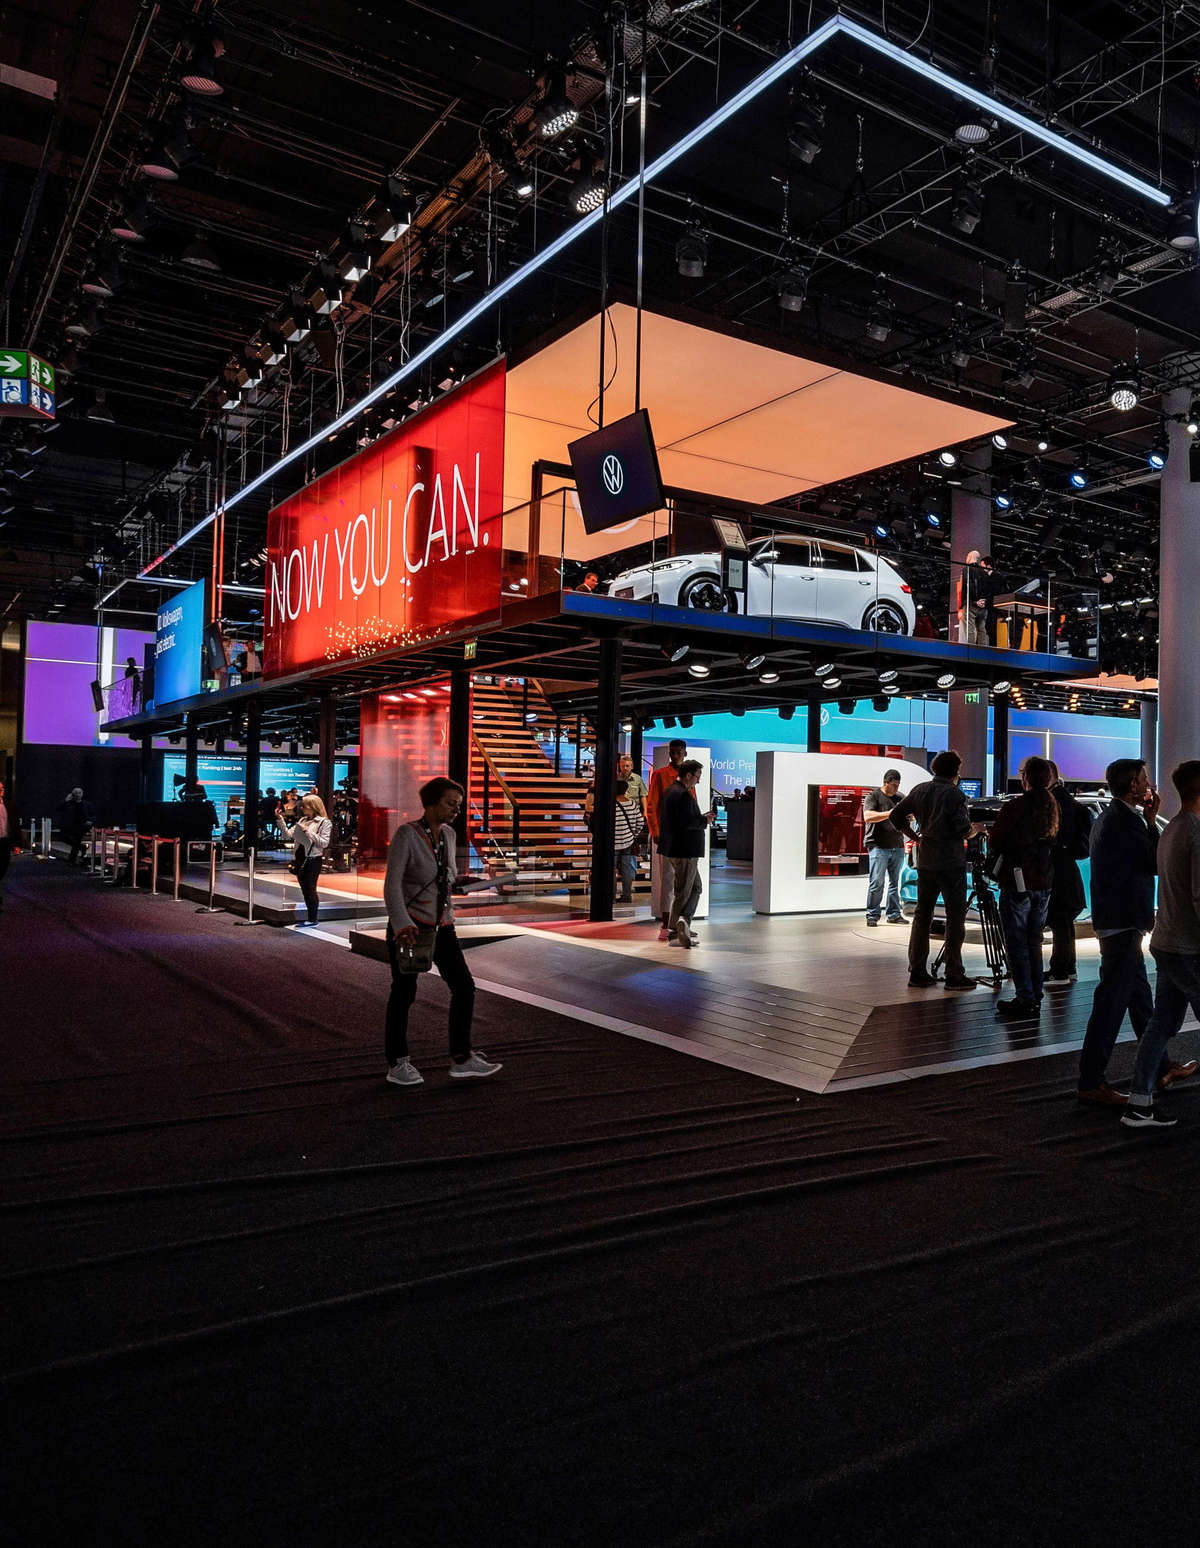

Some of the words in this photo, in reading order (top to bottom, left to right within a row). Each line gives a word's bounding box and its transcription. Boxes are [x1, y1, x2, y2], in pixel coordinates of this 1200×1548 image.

[270, 533, 329, 628] NOW
[334, 499, 392, 600] YOU
[402, 451, 489, 574] CAN.
[723, 774, 743, 786] The
